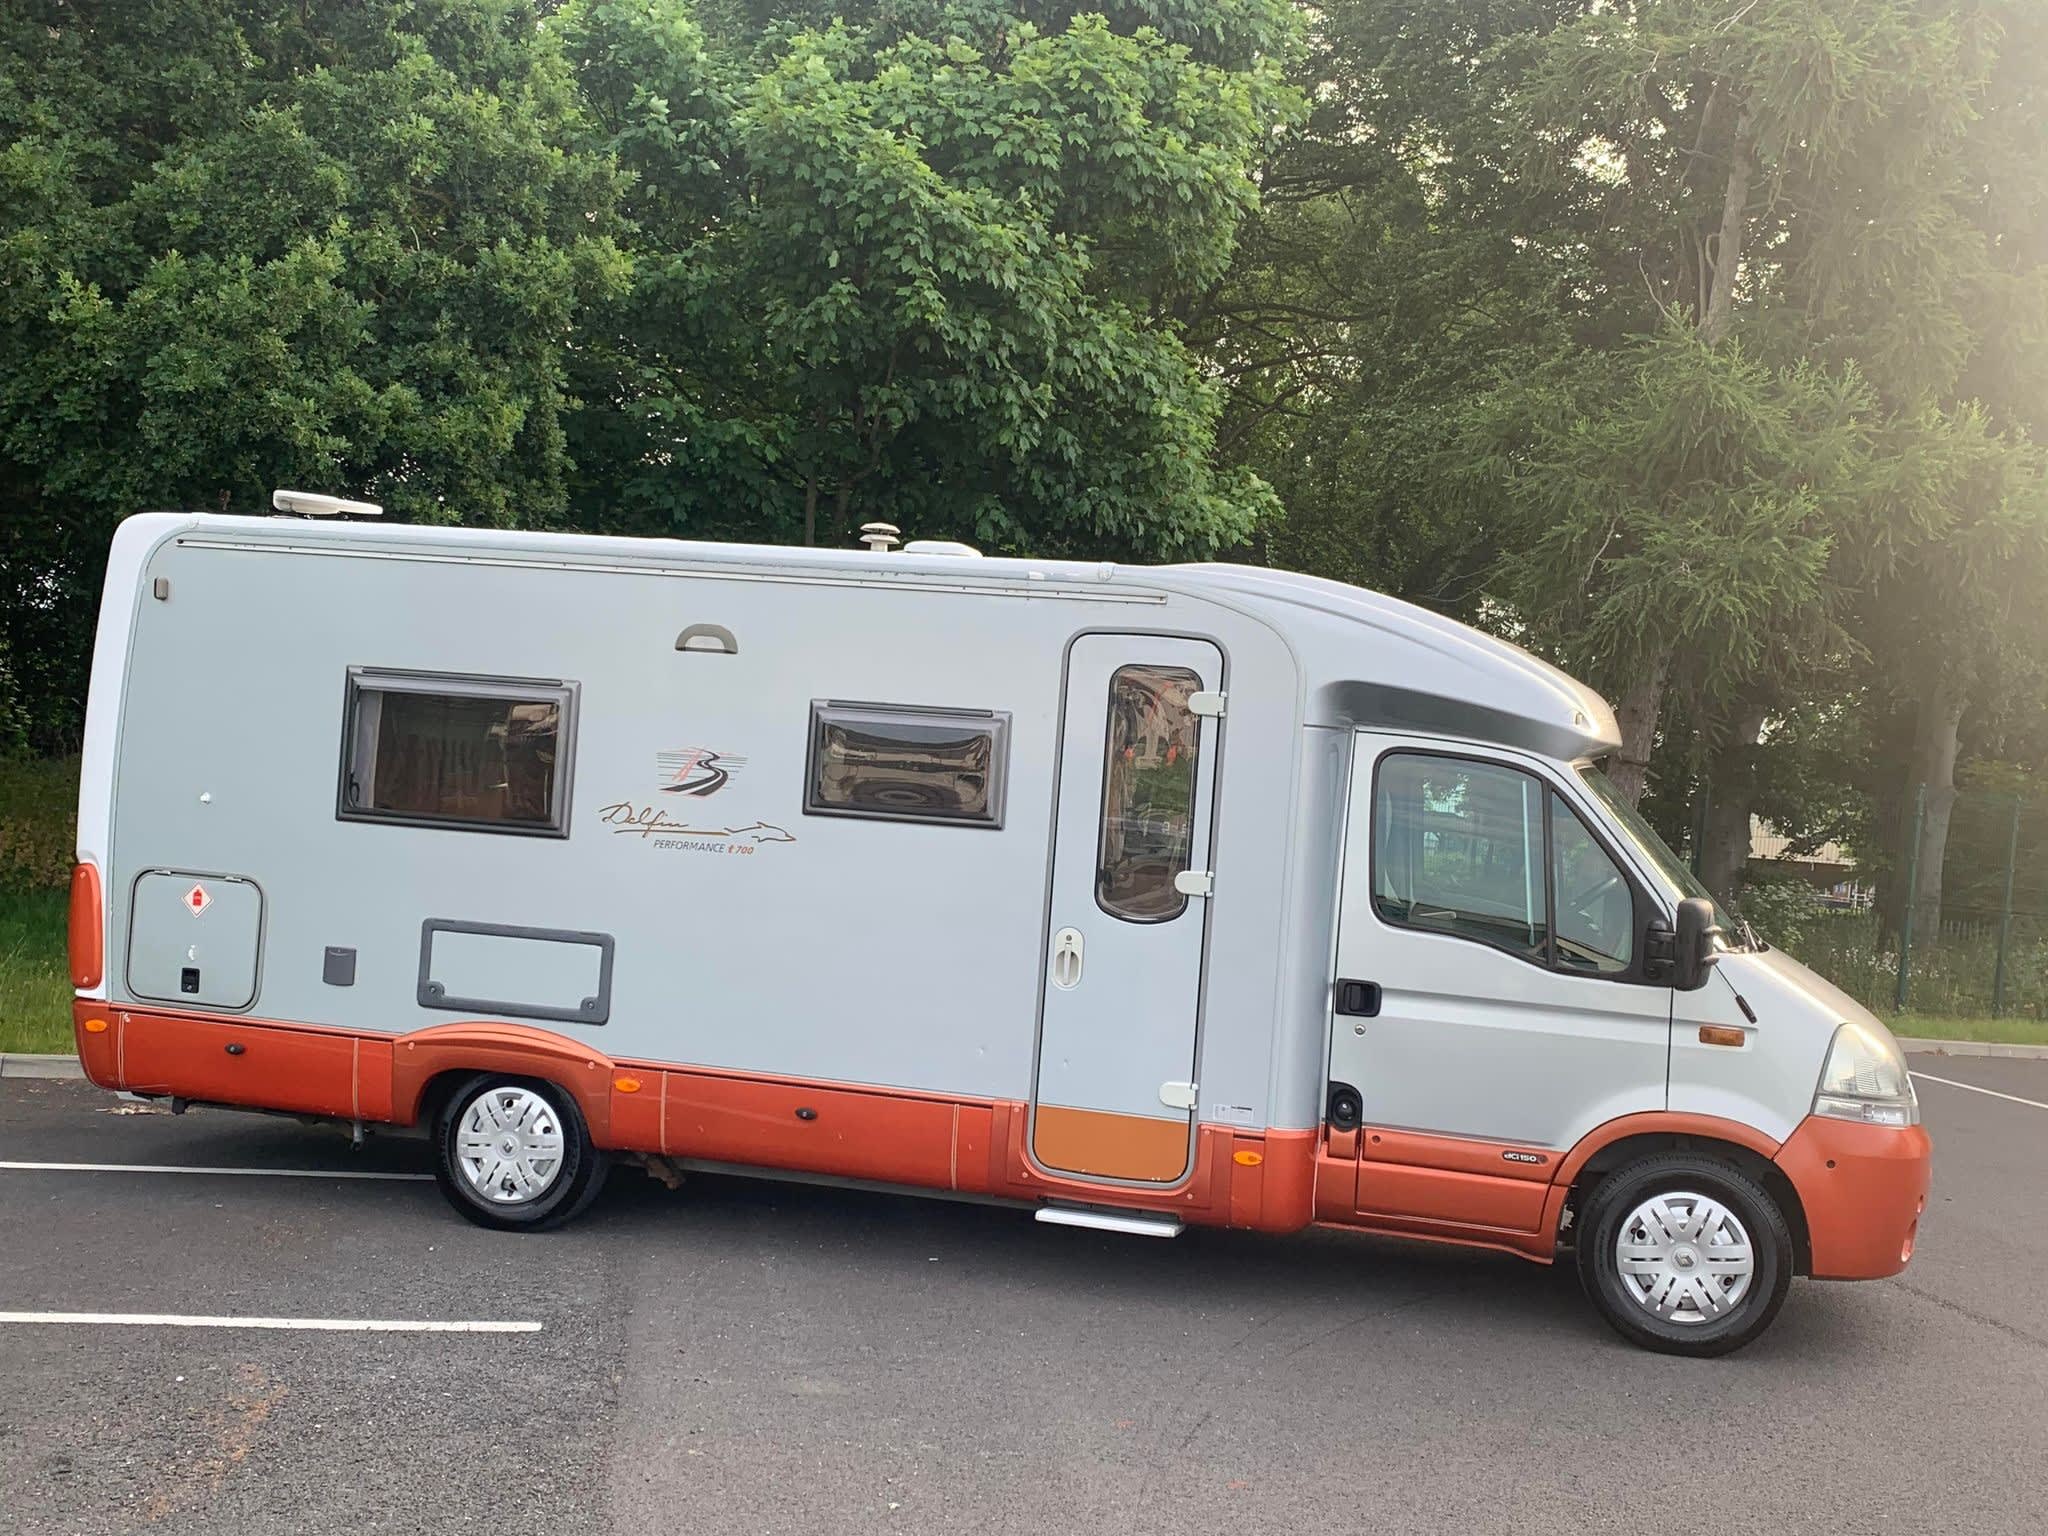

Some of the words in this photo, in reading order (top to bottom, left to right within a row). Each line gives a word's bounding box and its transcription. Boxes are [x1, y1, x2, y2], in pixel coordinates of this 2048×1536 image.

[599, 801, 689, 838] Delfin
[653, 839, 726, 854] PERFORMANCE
[735, 845, 754, 855] 700
[1520, 1154, 1537, 1162] 150
